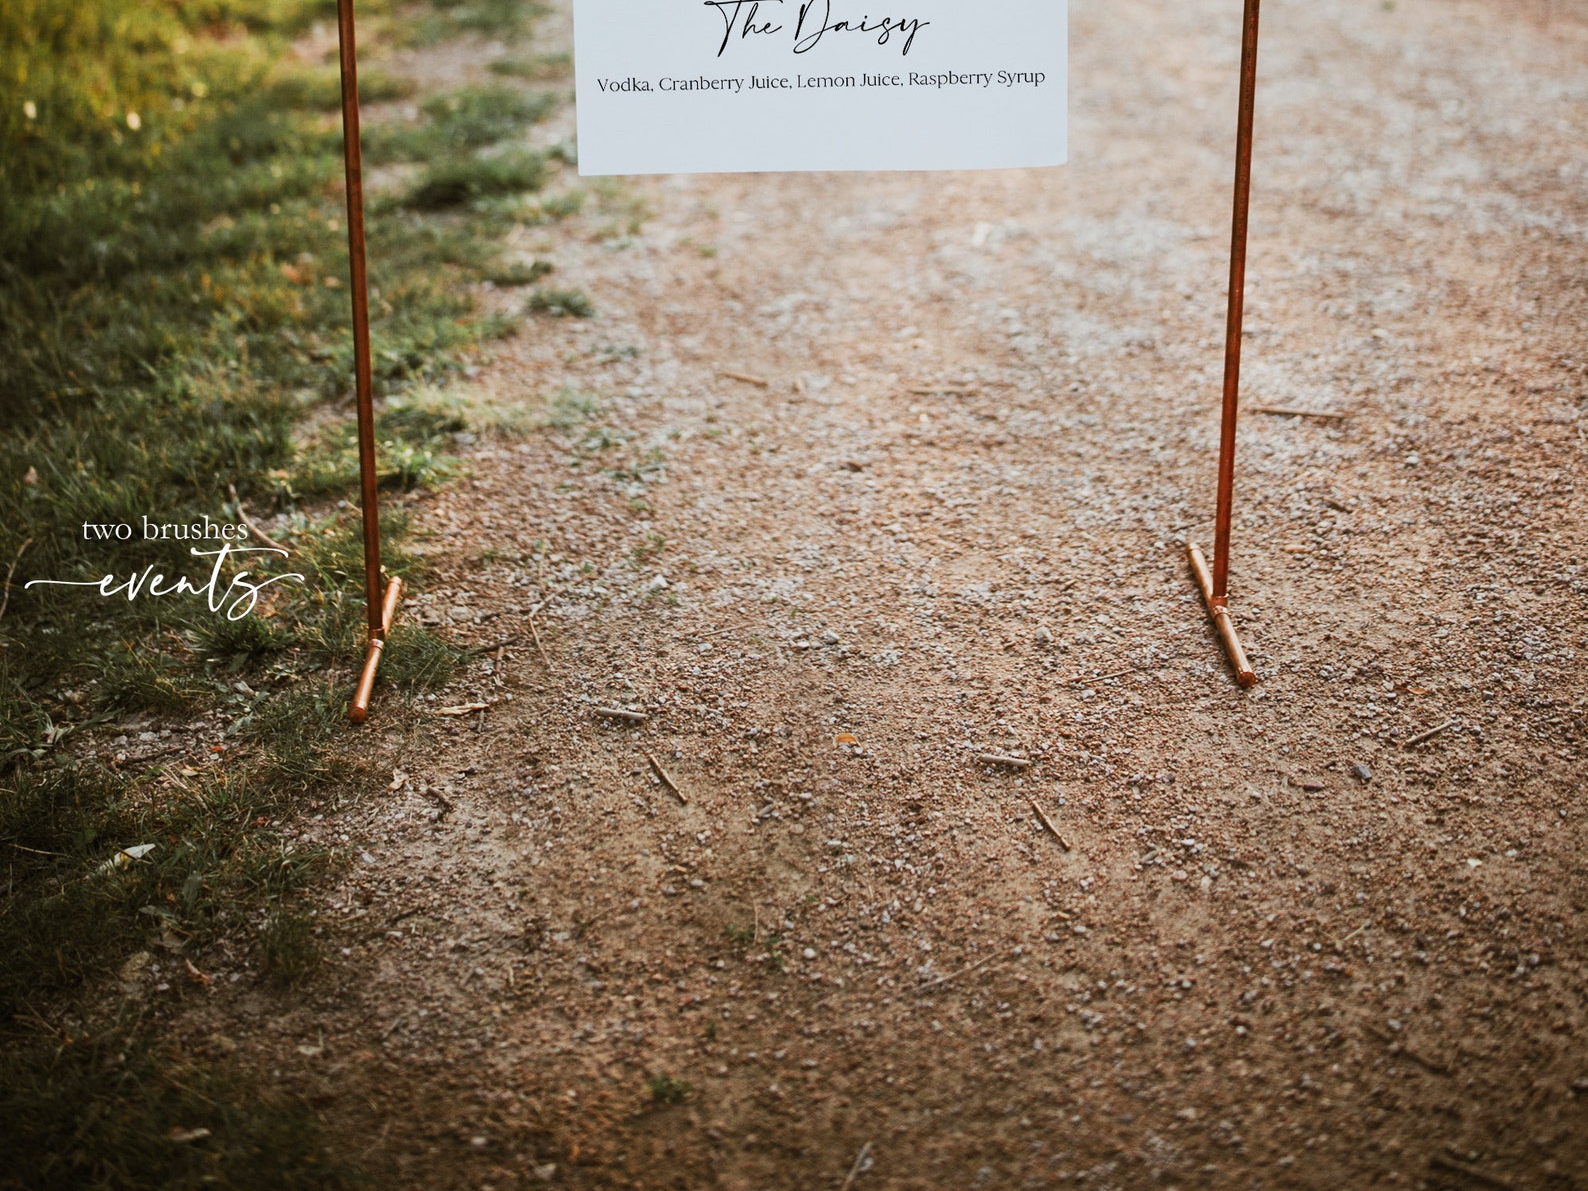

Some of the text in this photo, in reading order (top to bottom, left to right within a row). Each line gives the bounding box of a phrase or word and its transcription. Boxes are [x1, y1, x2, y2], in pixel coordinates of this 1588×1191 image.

[597, 70, 1046, 94] Vodka, Cranberry Juice, Lemon Juice, Raspberry Syrup
